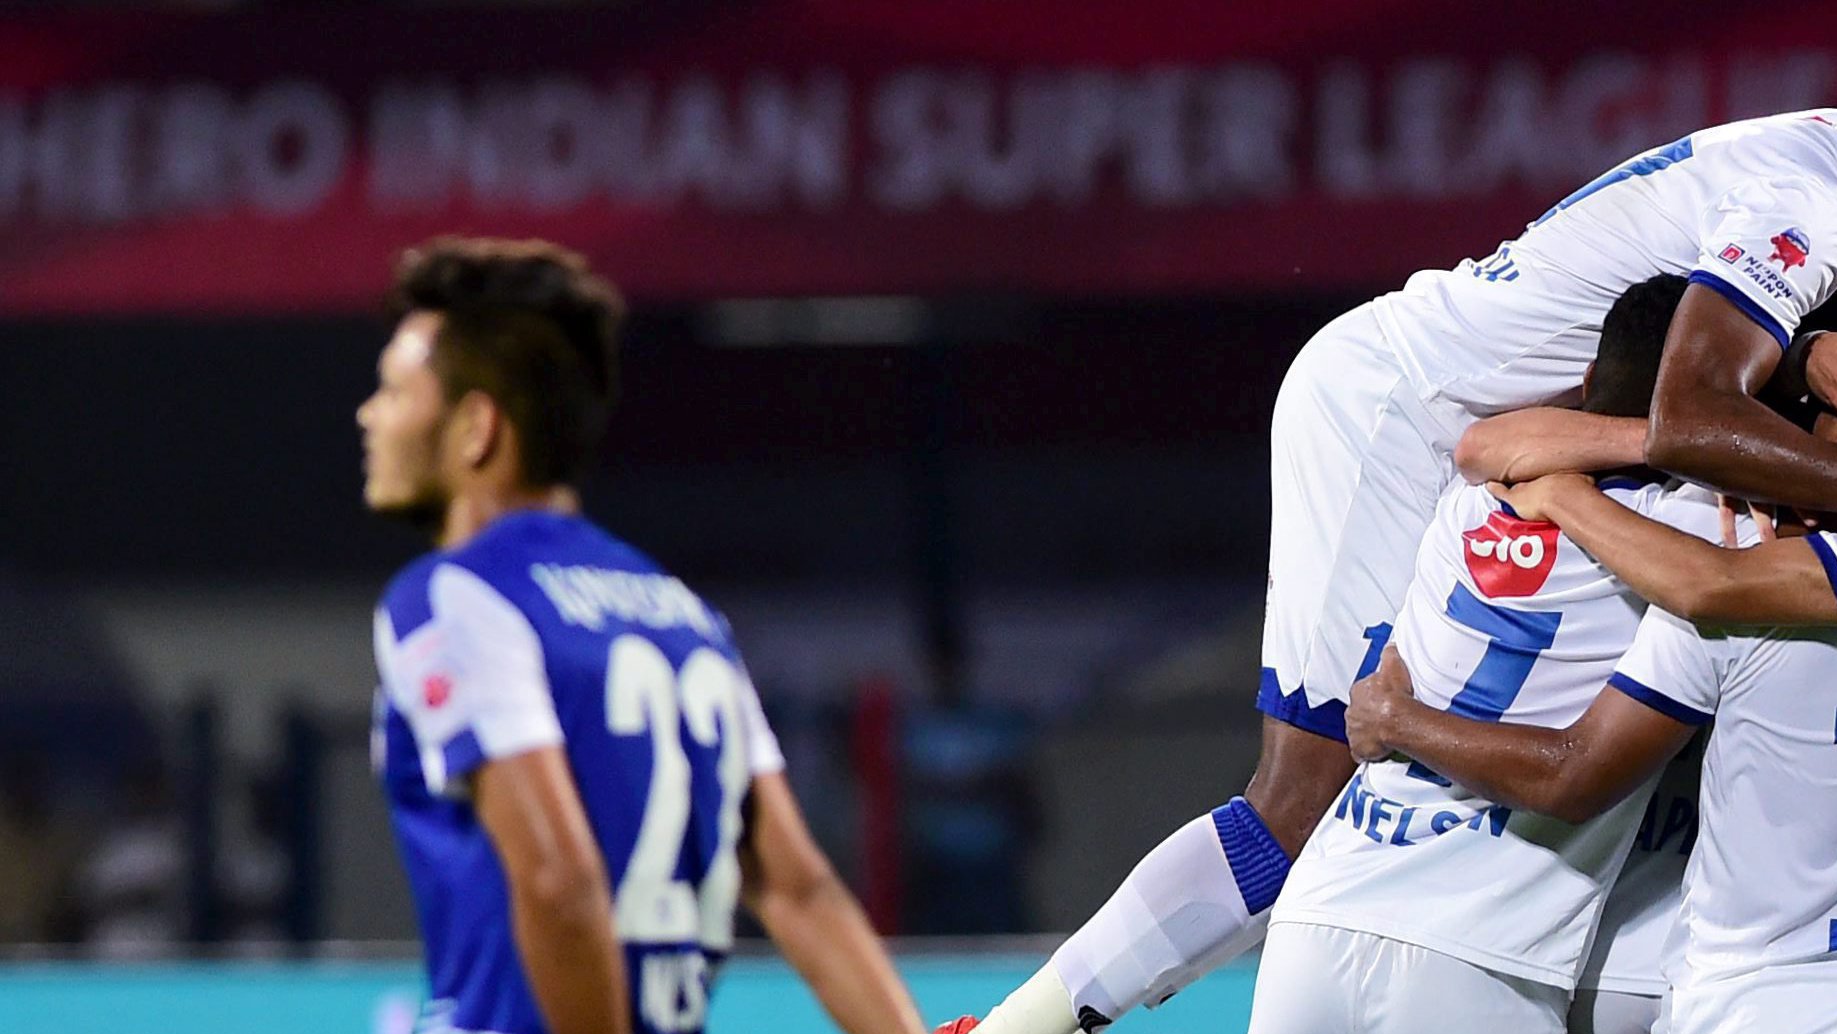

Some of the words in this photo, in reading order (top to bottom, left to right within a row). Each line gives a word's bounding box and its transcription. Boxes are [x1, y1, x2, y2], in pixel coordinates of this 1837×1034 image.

[0, 80, 347, 220] HERO
[368, 73, 848, 212] INDIAN
[868, 62, 1296, 210] SUPER
[1742, 266, 1783, 300] PAINT
